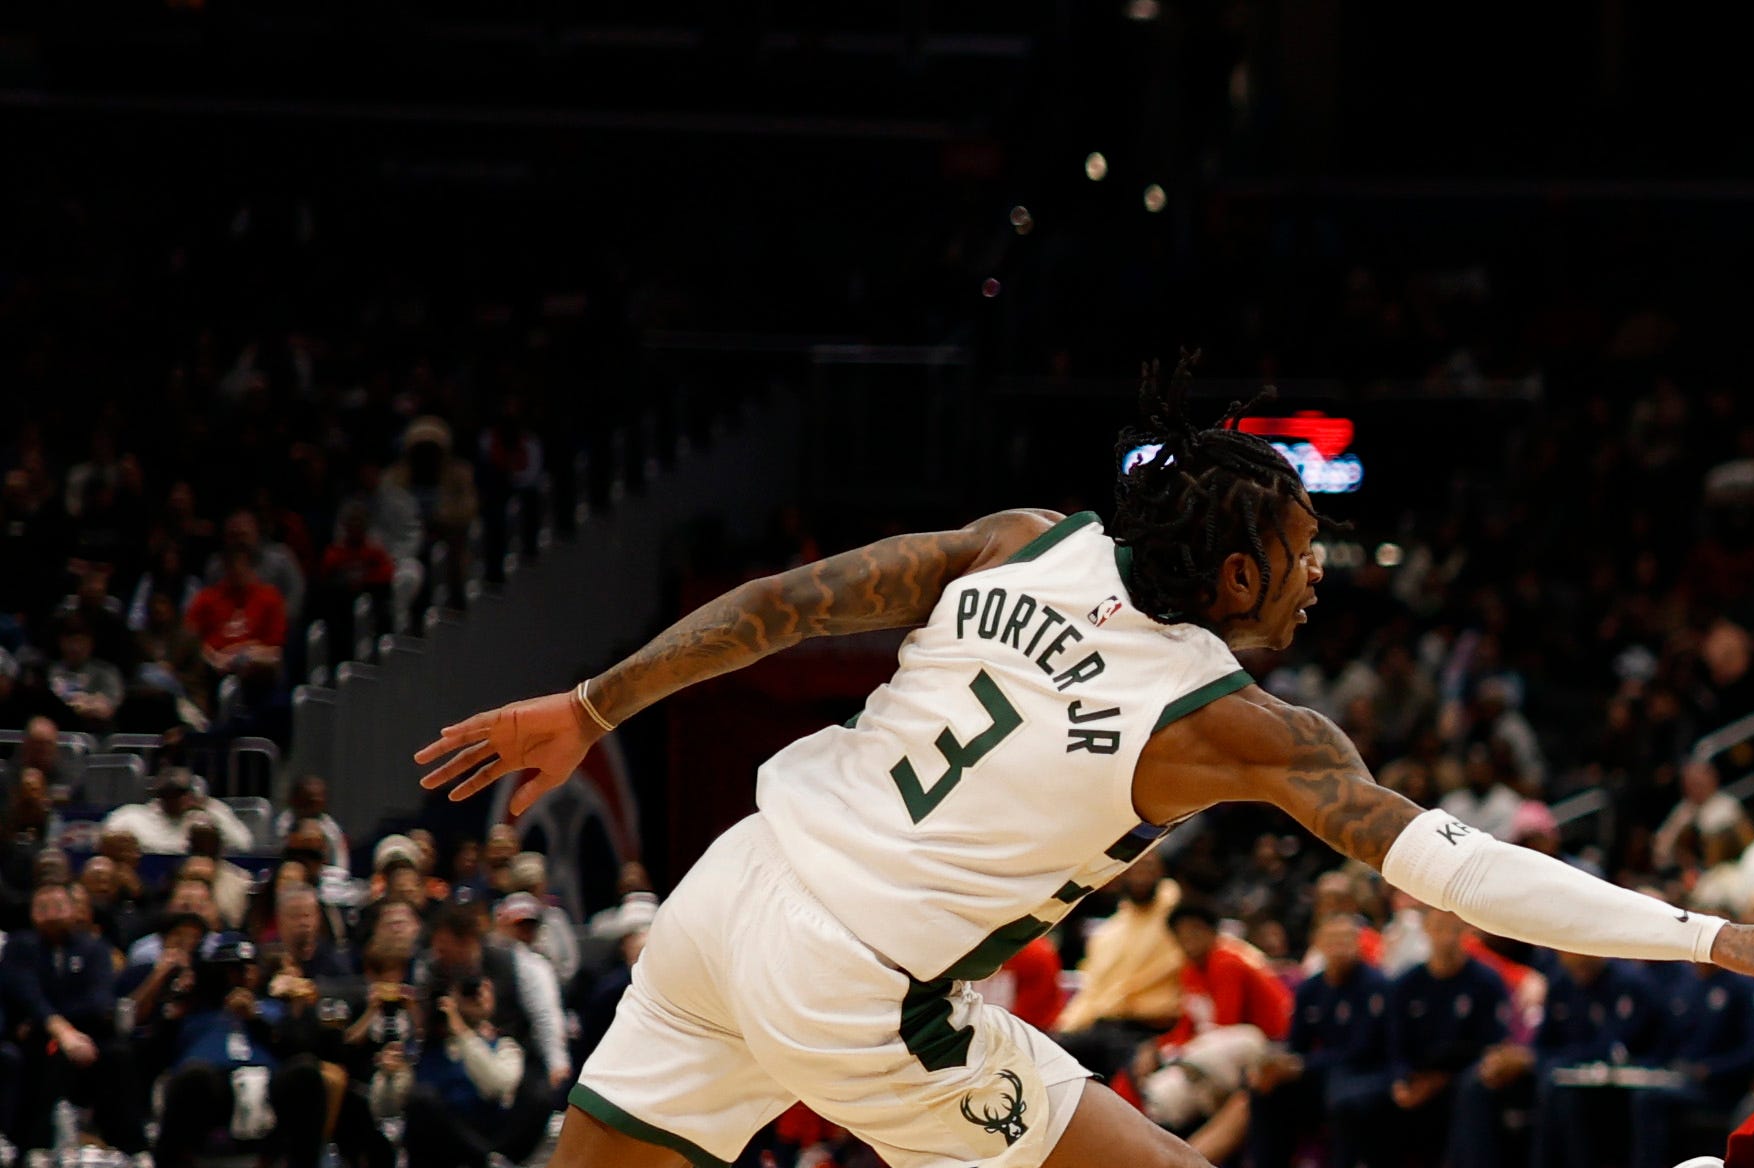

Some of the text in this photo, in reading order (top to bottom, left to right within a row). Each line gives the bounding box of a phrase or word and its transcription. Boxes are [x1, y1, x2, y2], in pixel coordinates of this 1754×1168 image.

[890, 668, 1024, 825] 3
[957, 588, 1121, 754] PORTER JR
